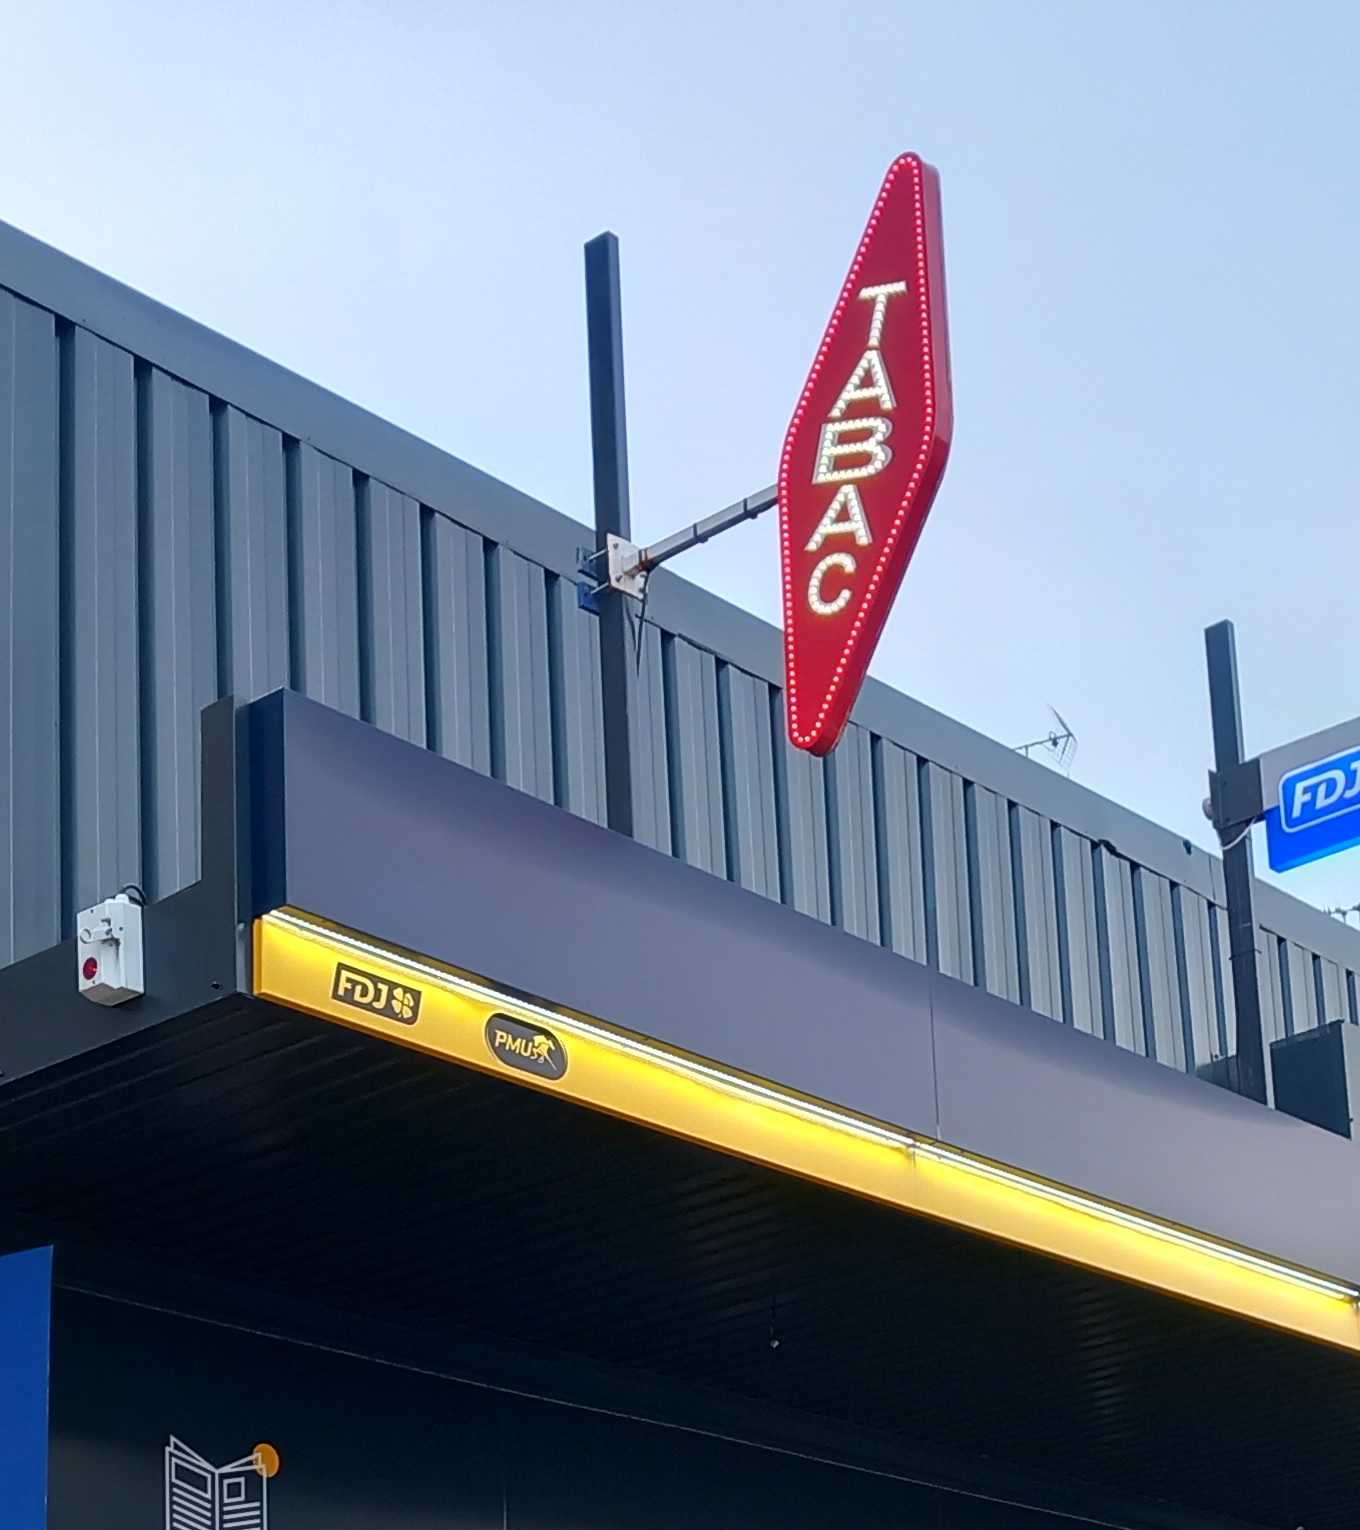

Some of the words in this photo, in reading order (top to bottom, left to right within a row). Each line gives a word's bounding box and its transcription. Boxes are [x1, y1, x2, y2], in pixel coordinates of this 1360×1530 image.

[804, 280, 907, 617] TABAC
[337, 969, 389, 1010] FDJ
[494, 1029, 532, 1058] PMU
